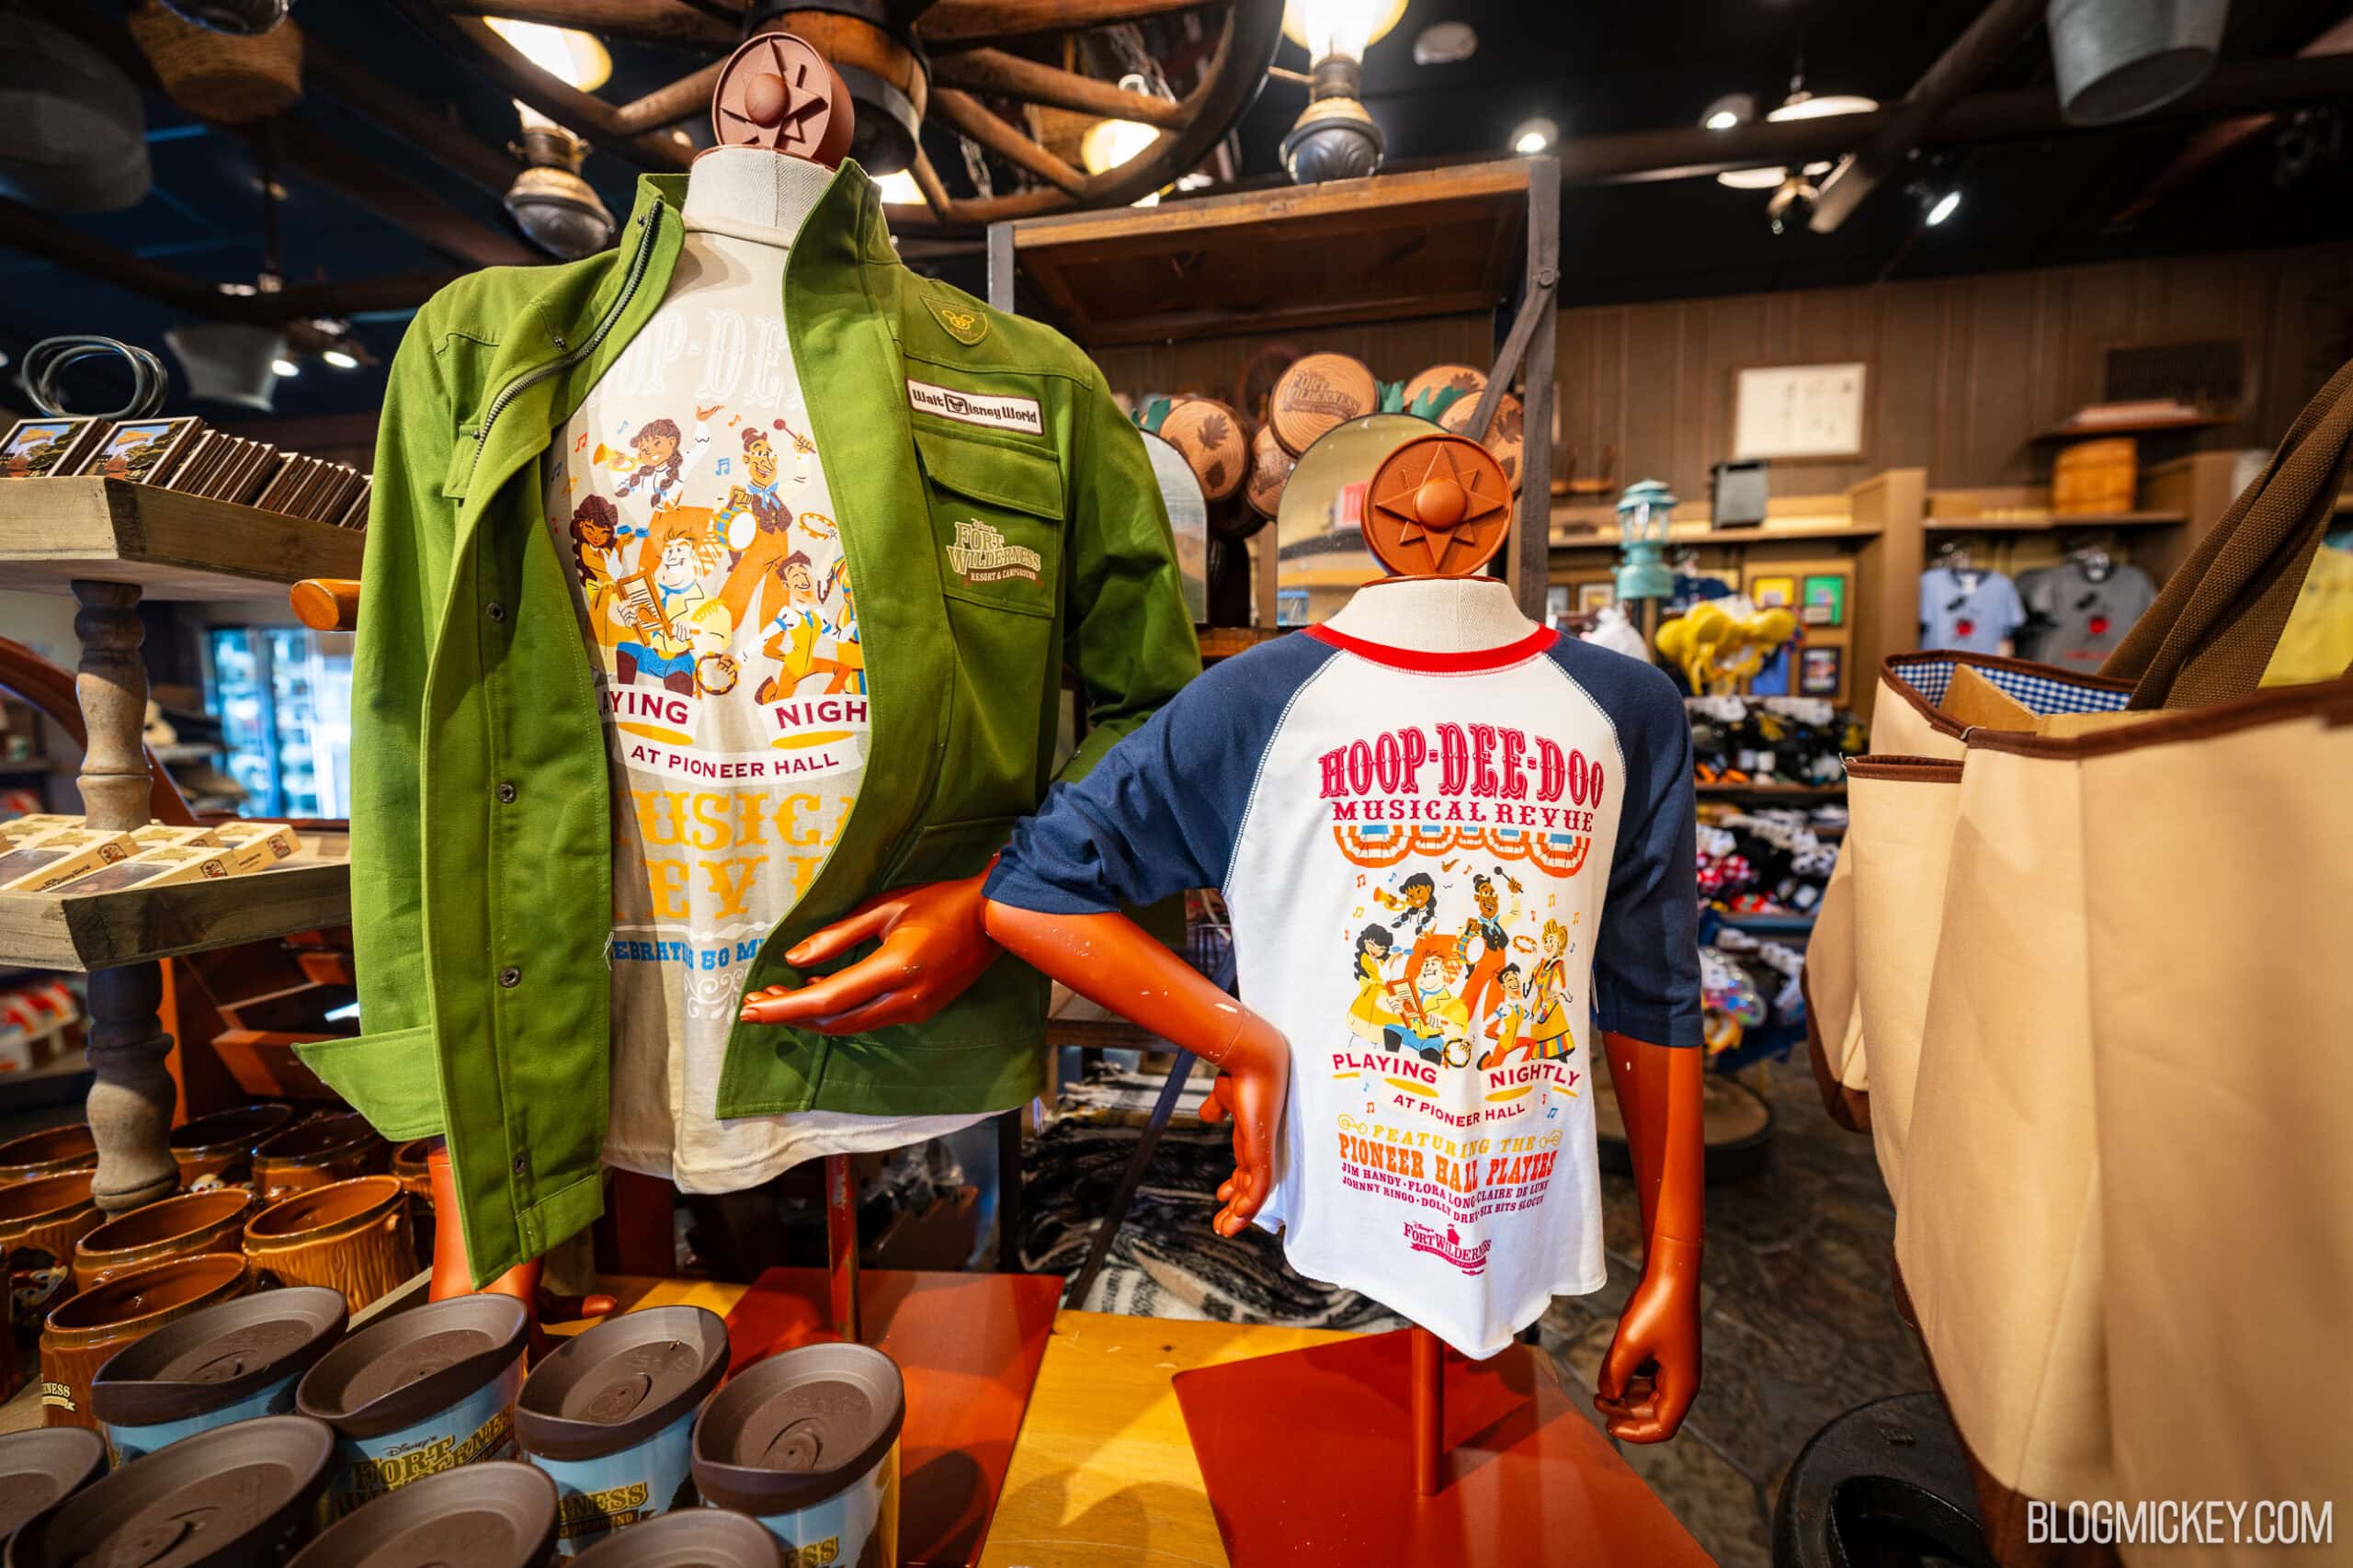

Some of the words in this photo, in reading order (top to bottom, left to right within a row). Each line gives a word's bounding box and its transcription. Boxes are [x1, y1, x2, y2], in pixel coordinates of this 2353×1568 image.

[912, 389, 945, 407] Walt
[943, 392, 1003, 420] Disney
[1002, 406, 1038, 424] World
[955, 521, 1006, 551] FORT
[947, 545, 1041, 575] WILDERNESS
[631, 744, 660, 765] AT
[668, 754, 765, 778] PIONEER
[774, 753, 839, 776] HALL
[1316, 721, 1605, 810] HOOP-DEE-DOO
[1332, 800, 1487, 823] MUSICAL
[1494, 802, 1595, 833] REVUE
[1333, 1052, 1438, 1085] PLAYING
[1489, 1063, 1582, 1089] NIGHTLY
[1392, 1094, 1415, 1110] AT
[1418, 1102, 1481, 1128] PIONEER
[1484, 1103, 1527, 1121] HALL
[1372, 1124, 1491, 1159] FEATURING
[1500, 1136, 1538, 1154] THE
[1338, 1132, 1425, 1179] PIONEER
[1434, 1153, 1479, 1193] HALL
[1484, 1150, 1559, 1187] PLAYERS
[1341, 1163, 1360, 1177] JIM
[1342, 1176, 1380, 1194] JOHNNY
[1404, 1221, 1434, 1246] FORT
